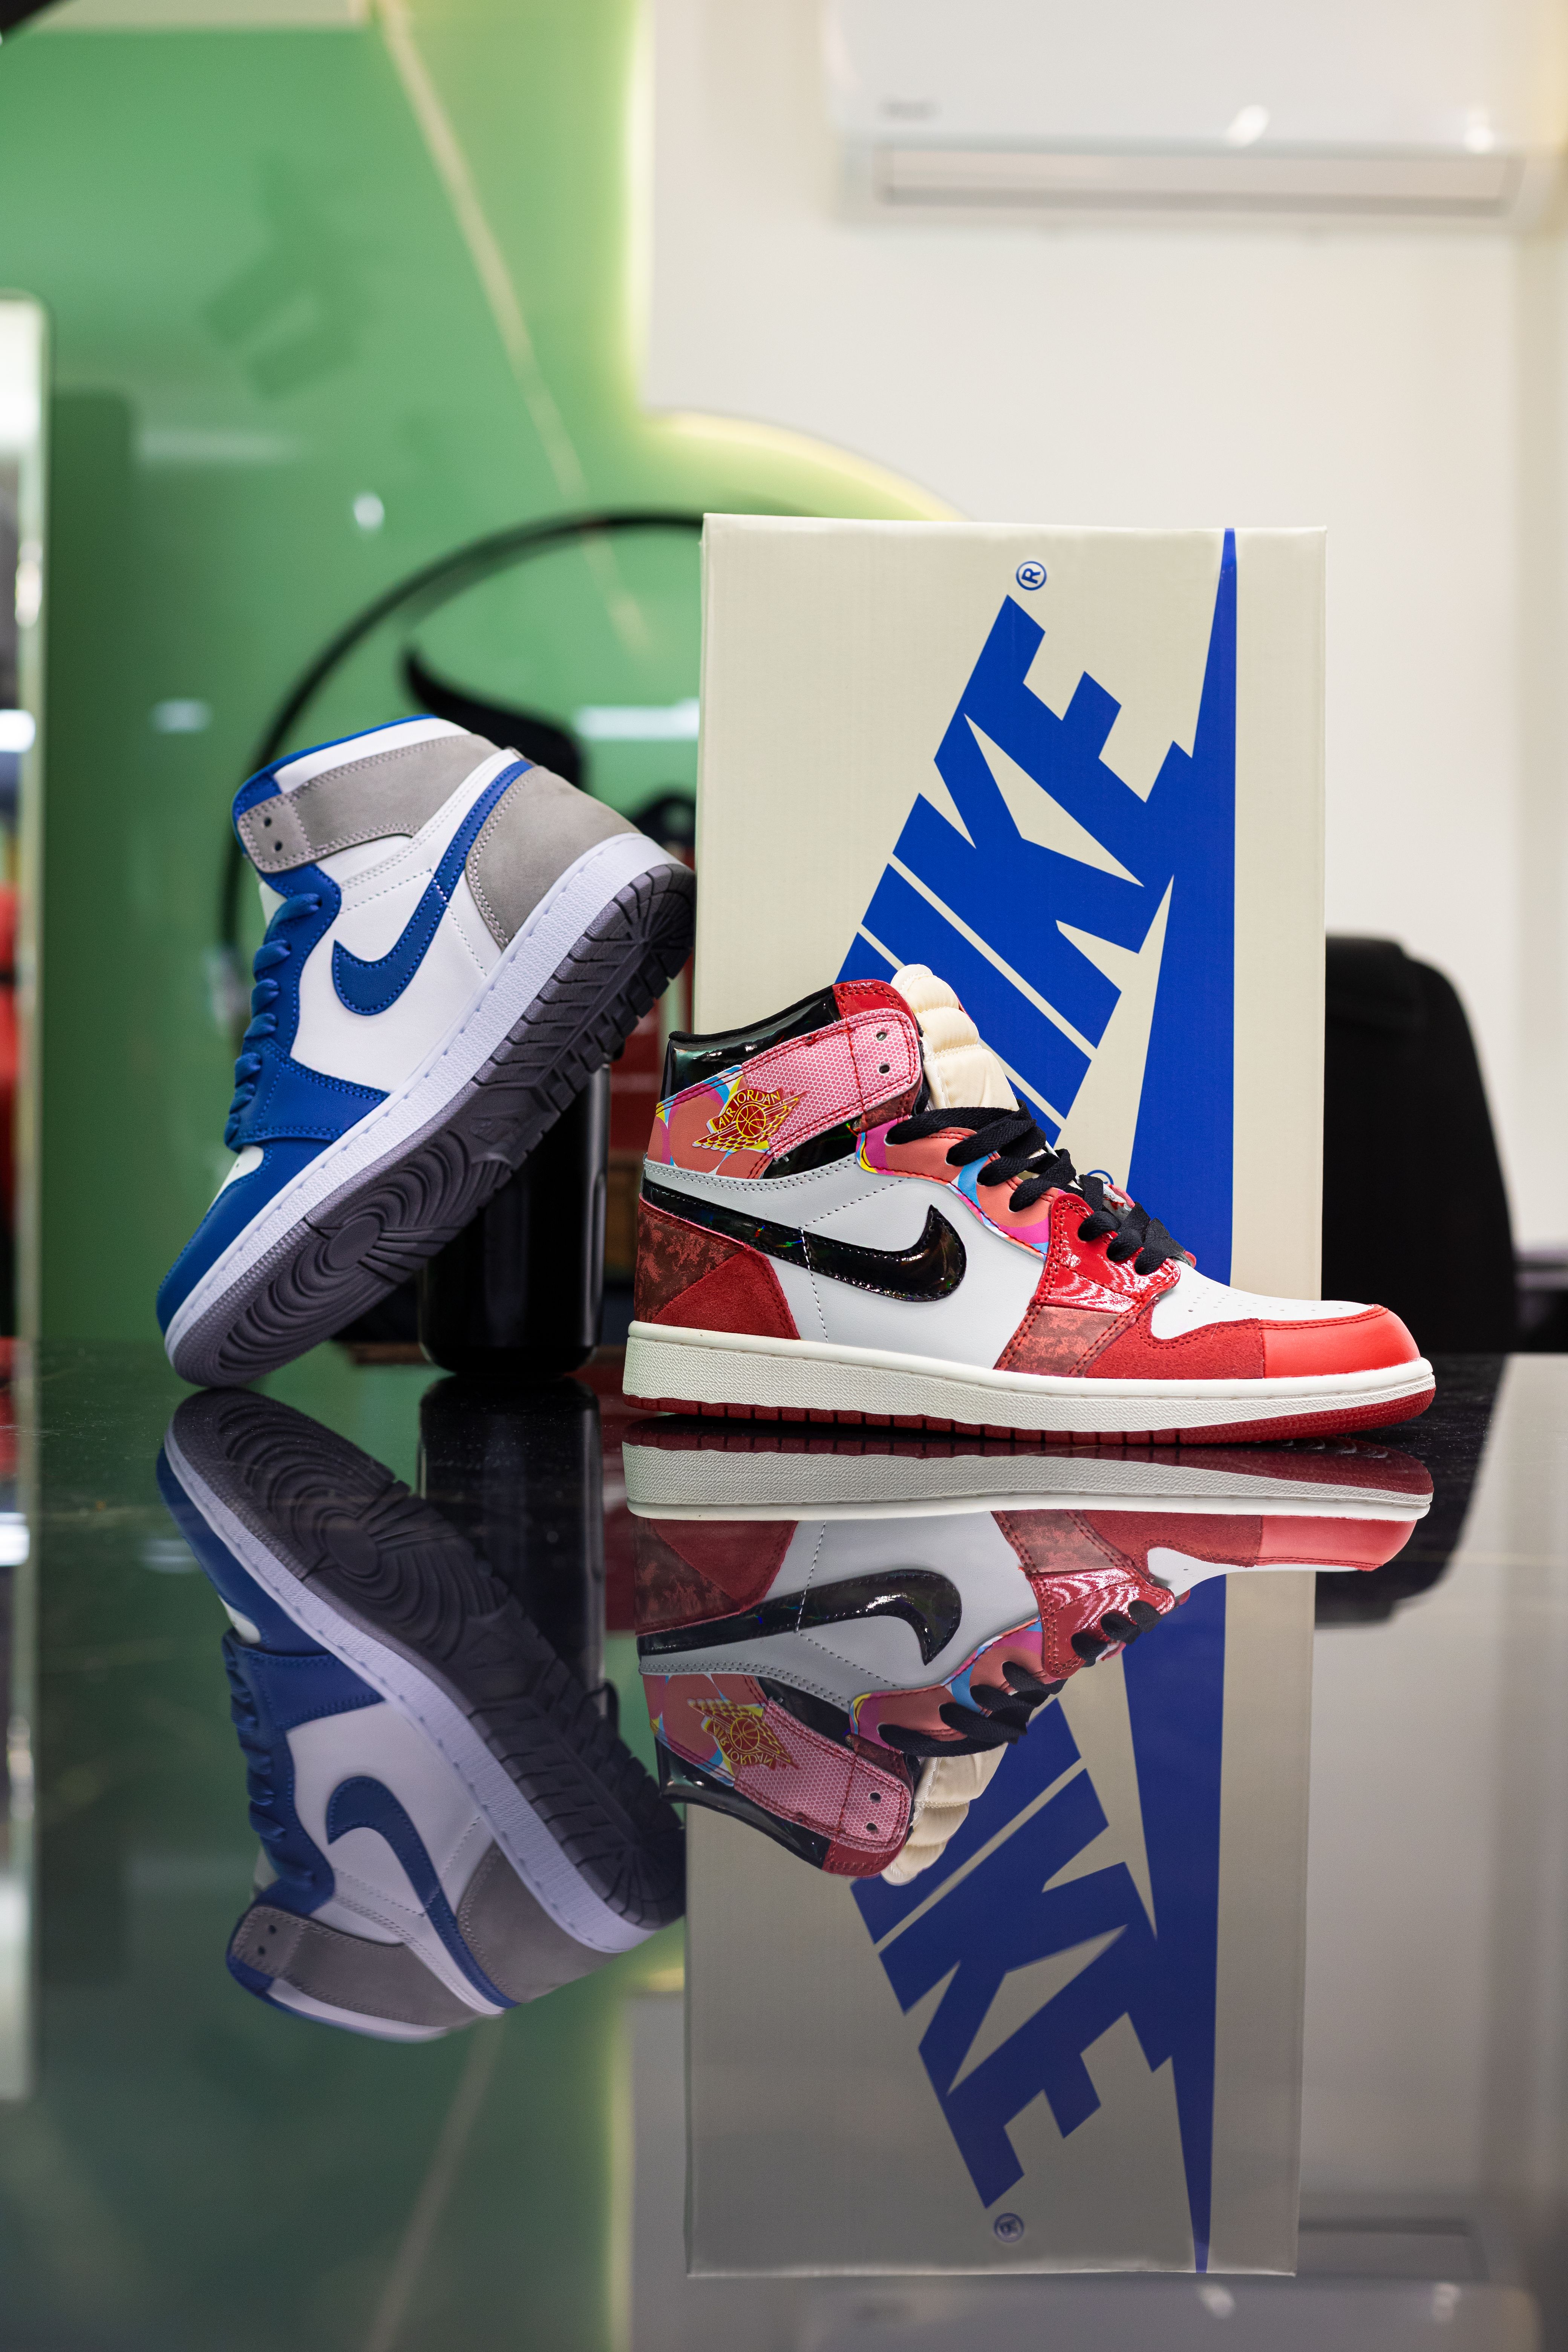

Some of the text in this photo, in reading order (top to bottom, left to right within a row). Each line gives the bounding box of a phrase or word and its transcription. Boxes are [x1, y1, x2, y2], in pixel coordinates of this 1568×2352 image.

[835, 594, 1193, 1149] IKE
[719, 1089, 781, 1128] AIR JORDAN
